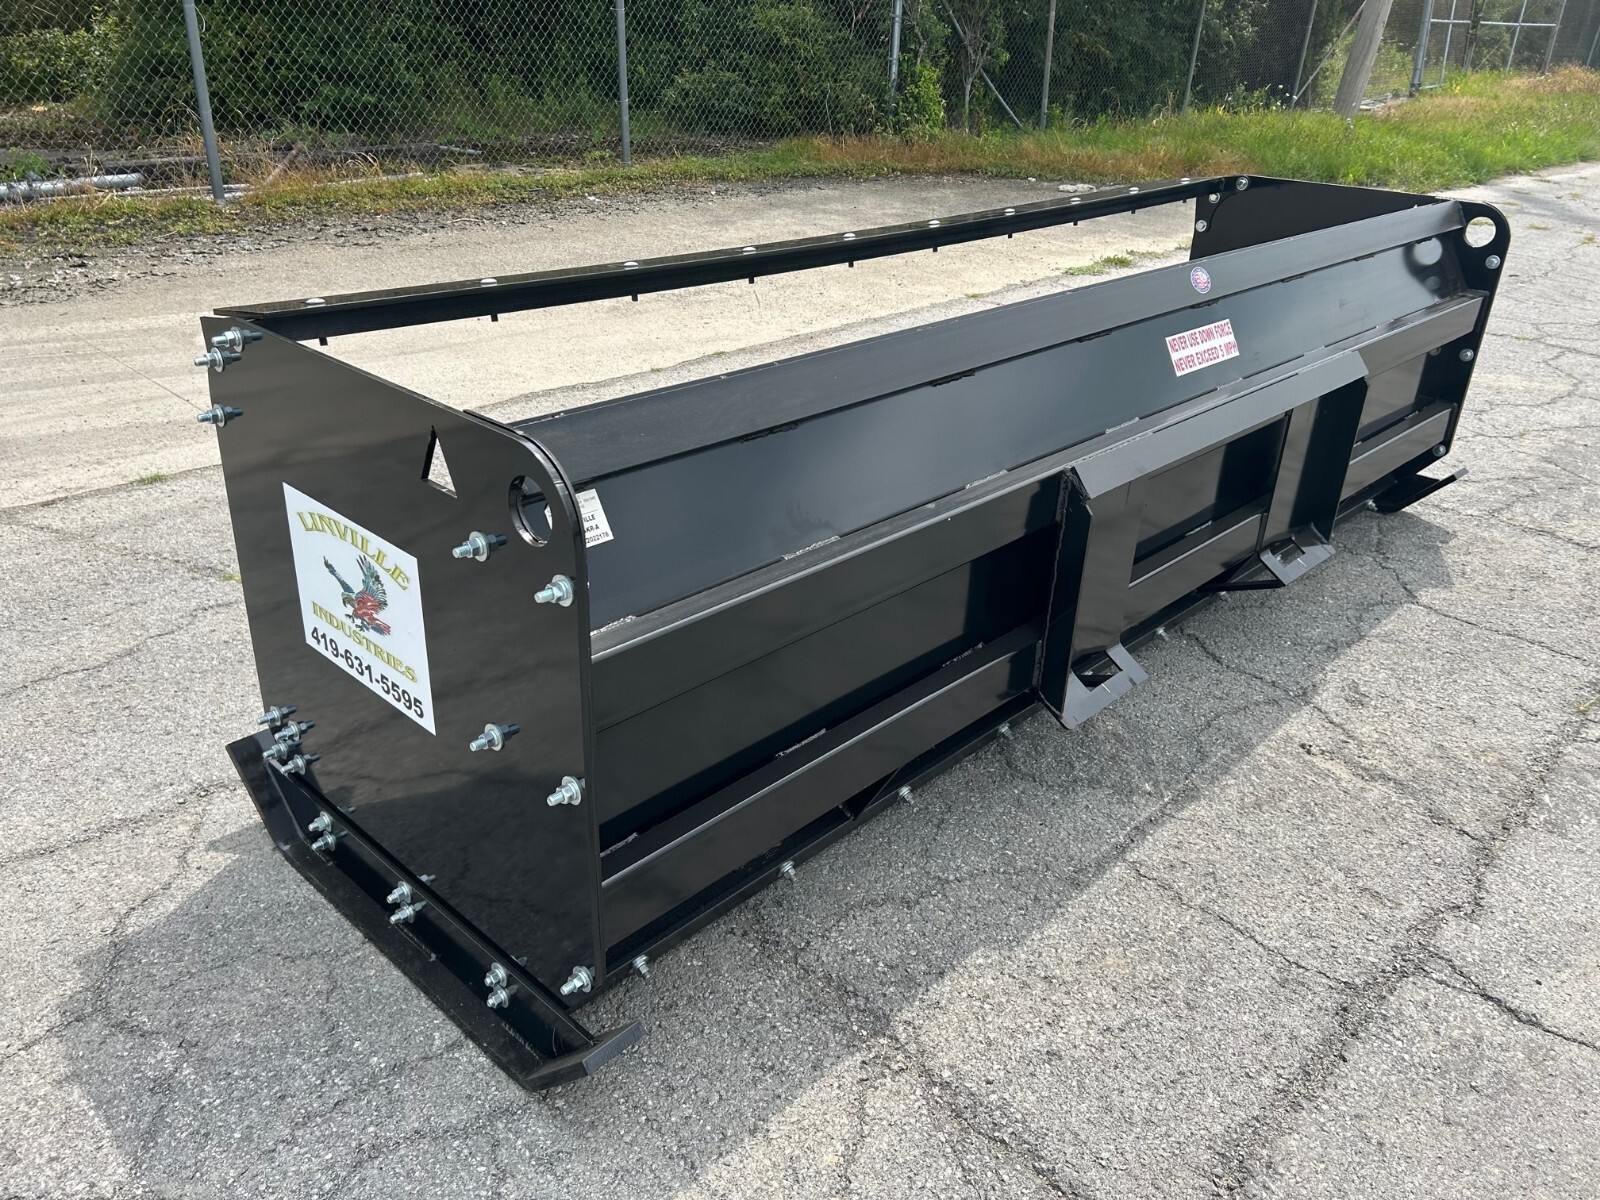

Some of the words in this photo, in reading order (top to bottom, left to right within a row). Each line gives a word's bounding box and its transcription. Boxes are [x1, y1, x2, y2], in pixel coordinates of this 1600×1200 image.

[1168, 335, 1189, 354] NEVER
[1187, 331, 1200, 348] USE
[1198, 327, 1216, 344] DOWN
[1214, 321, 1232, 339] FORCE
[1174, 354, 1197, 373] NEVER
[1195, 346, 1220, 366] EXCEED
[1219, 344, 1225, 357] 5
[1223, 340, 1238, 356] MPH
[297, 511, 410, 591] LINVILLE
[585, 524, 600, 533] KR-A
[312, 600, 418, 684] INDUSTRIES
[311, 626, 425, 719] 419-631-5595
